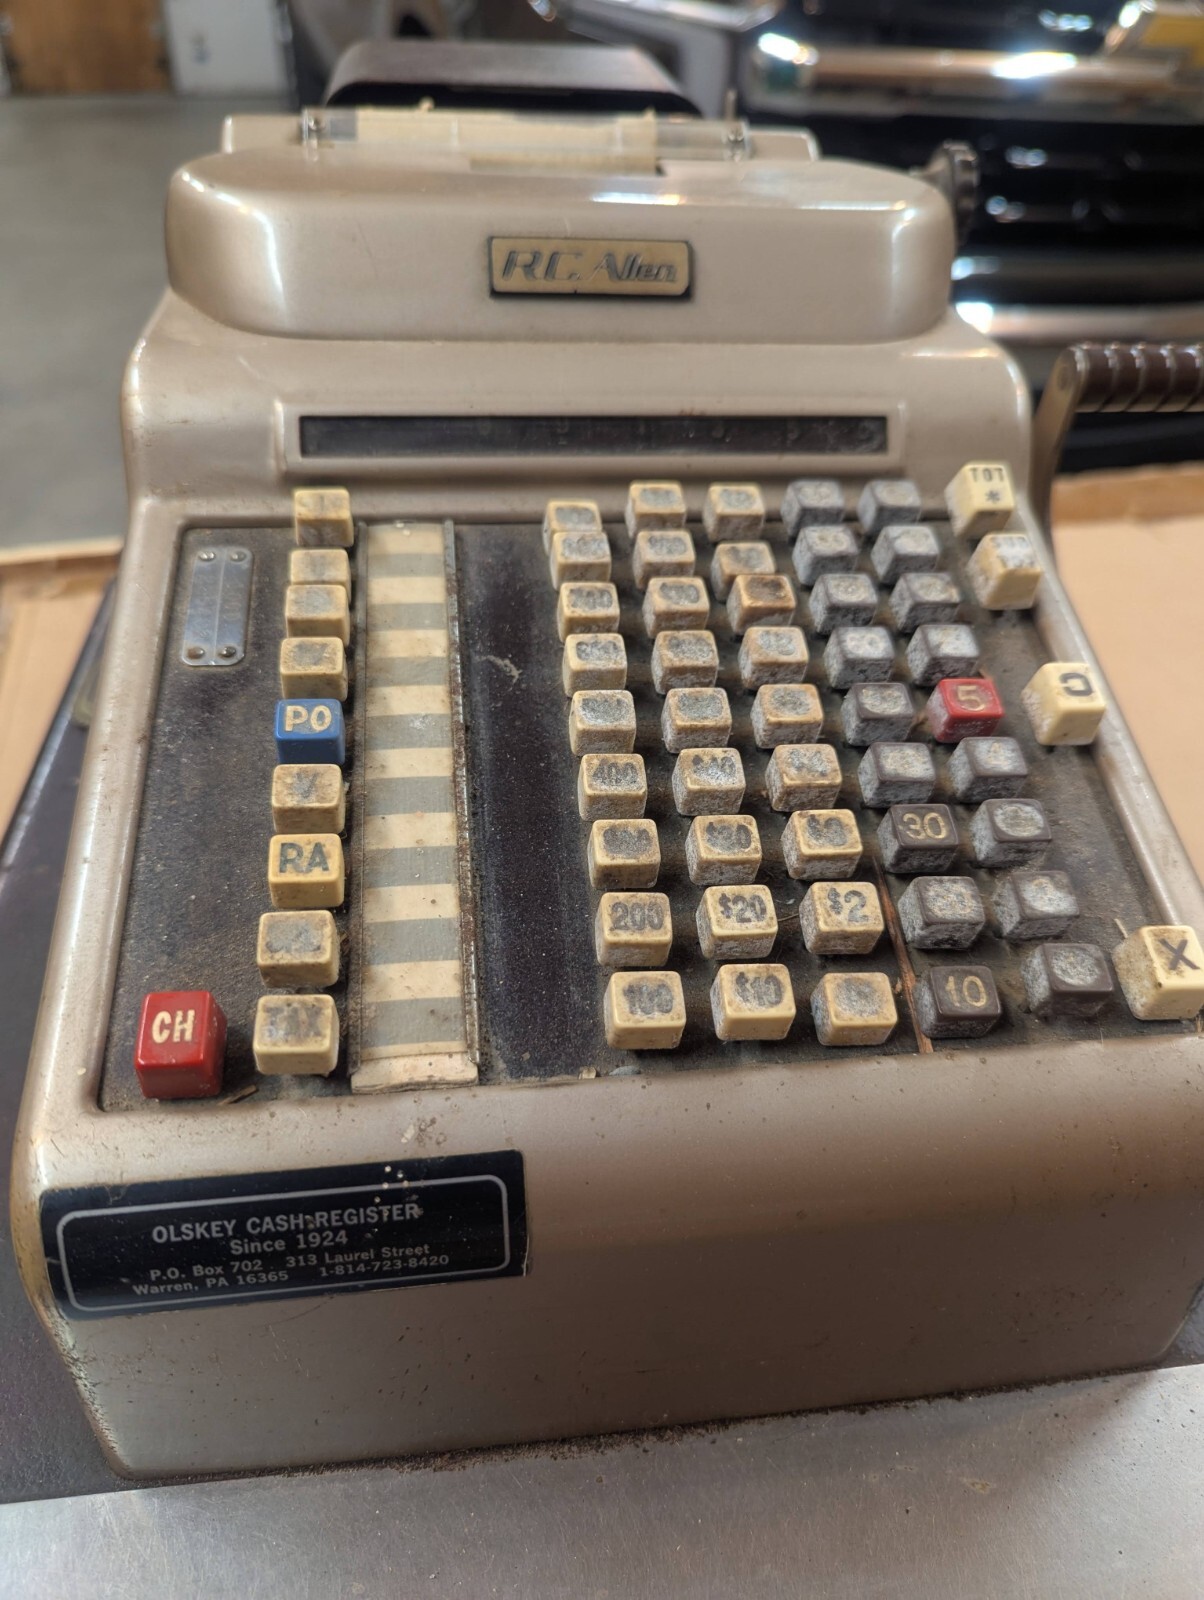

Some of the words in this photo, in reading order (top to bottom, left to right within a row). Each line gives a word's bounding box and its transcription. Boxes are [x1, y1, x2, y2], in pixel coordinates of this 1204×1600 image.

[589, 252, 678, 282] Allen
[969, 467, 1004, 482] TOT
[957, 685, 986, 711] 5
[284, 705, 331, 731] PO
[903, 812, 947, 839] 30
[278, 842, 330, 874] RA
[610, 902, 664, 931] 200
[718, 893, 767, 923] $20
[827, 888, 870, 923] $2
[1159, 938, 1201, 970] X
[945, 975, 987, 1007] 10
[152, 1009, 195, 1043] CH
[152, 1219, 236, 1243] OLSKEY
[246, 1213, 305, 1234] CASH
[314, 1203, 420, 1228] REGISTER
[230, 1238, 286, 1255] Since
[297, 1230, 348, 1249] 1924
[132, 1281, 199, 1295] Warren,
[206, 1277, 229, 1288] PA
[236, 1270, 289, 1285] 16365
[320, 1254, 450, 1277] 1-814-723-8420
[150, 1267, 186, 1280] P.O.
[192, 1264, 224, 1277] Box
[230, 1259, 263, 1273] 702
[286, 1254, 318, 1268] 313
[325, 1249, 375, 1264] Laurel
[381, 1244, 430, 1258] Street
